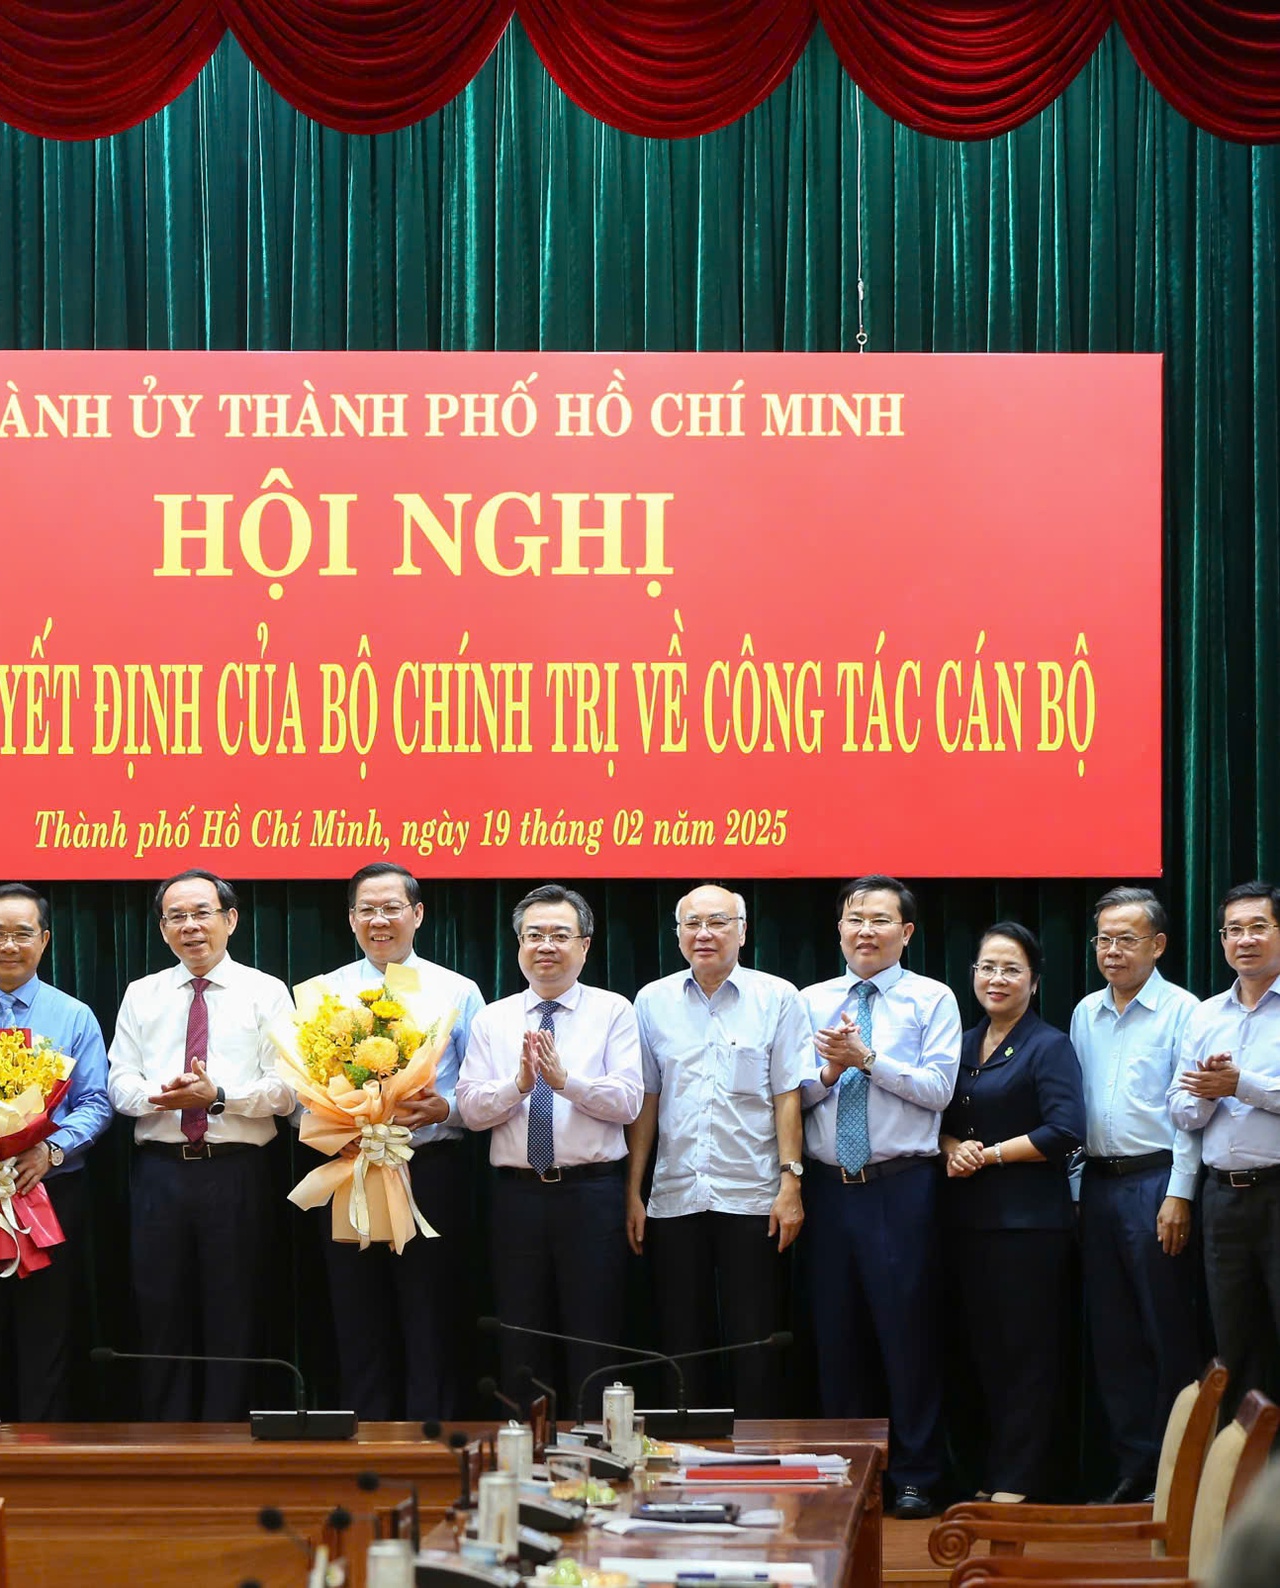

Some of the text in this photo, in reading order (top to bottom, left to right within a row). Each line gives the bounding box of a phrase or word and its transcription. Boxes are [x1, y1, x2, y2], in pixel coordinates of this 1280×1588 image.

[129, 375, 205, 440] ỦY
[219, 380, 410, 439] THÀNH
[425, 372, 539, 440] PHỐ
[554, 368, 633, 440] HỒ
[649, 380, 747, 440] CHÍ
[762, 393, 906, 439] MINH
[154, 468, 675, 601] HỘI NGHỊ
[93, 664, 204, 781] ĐỊNH
[218, 623, 307, 757] CỦA
[320, 635, 379, 781] BỘ
[394, 632, 534, 756] CHÍNH
[547, 663, 620, 779] TRỊ
[633, 609, 688, 756] VỀ
[705, 633, 825, 755] CÔNG
[838, 631, 922, 755] TÁC
[937, 631, 1026, 755] CÁN
[1038, 633, 1096, 779] BỘ
[37, 805, 788, 859] Thành phố Hồ Chí Minh, ngày 19 tháng 02 năm 2025
